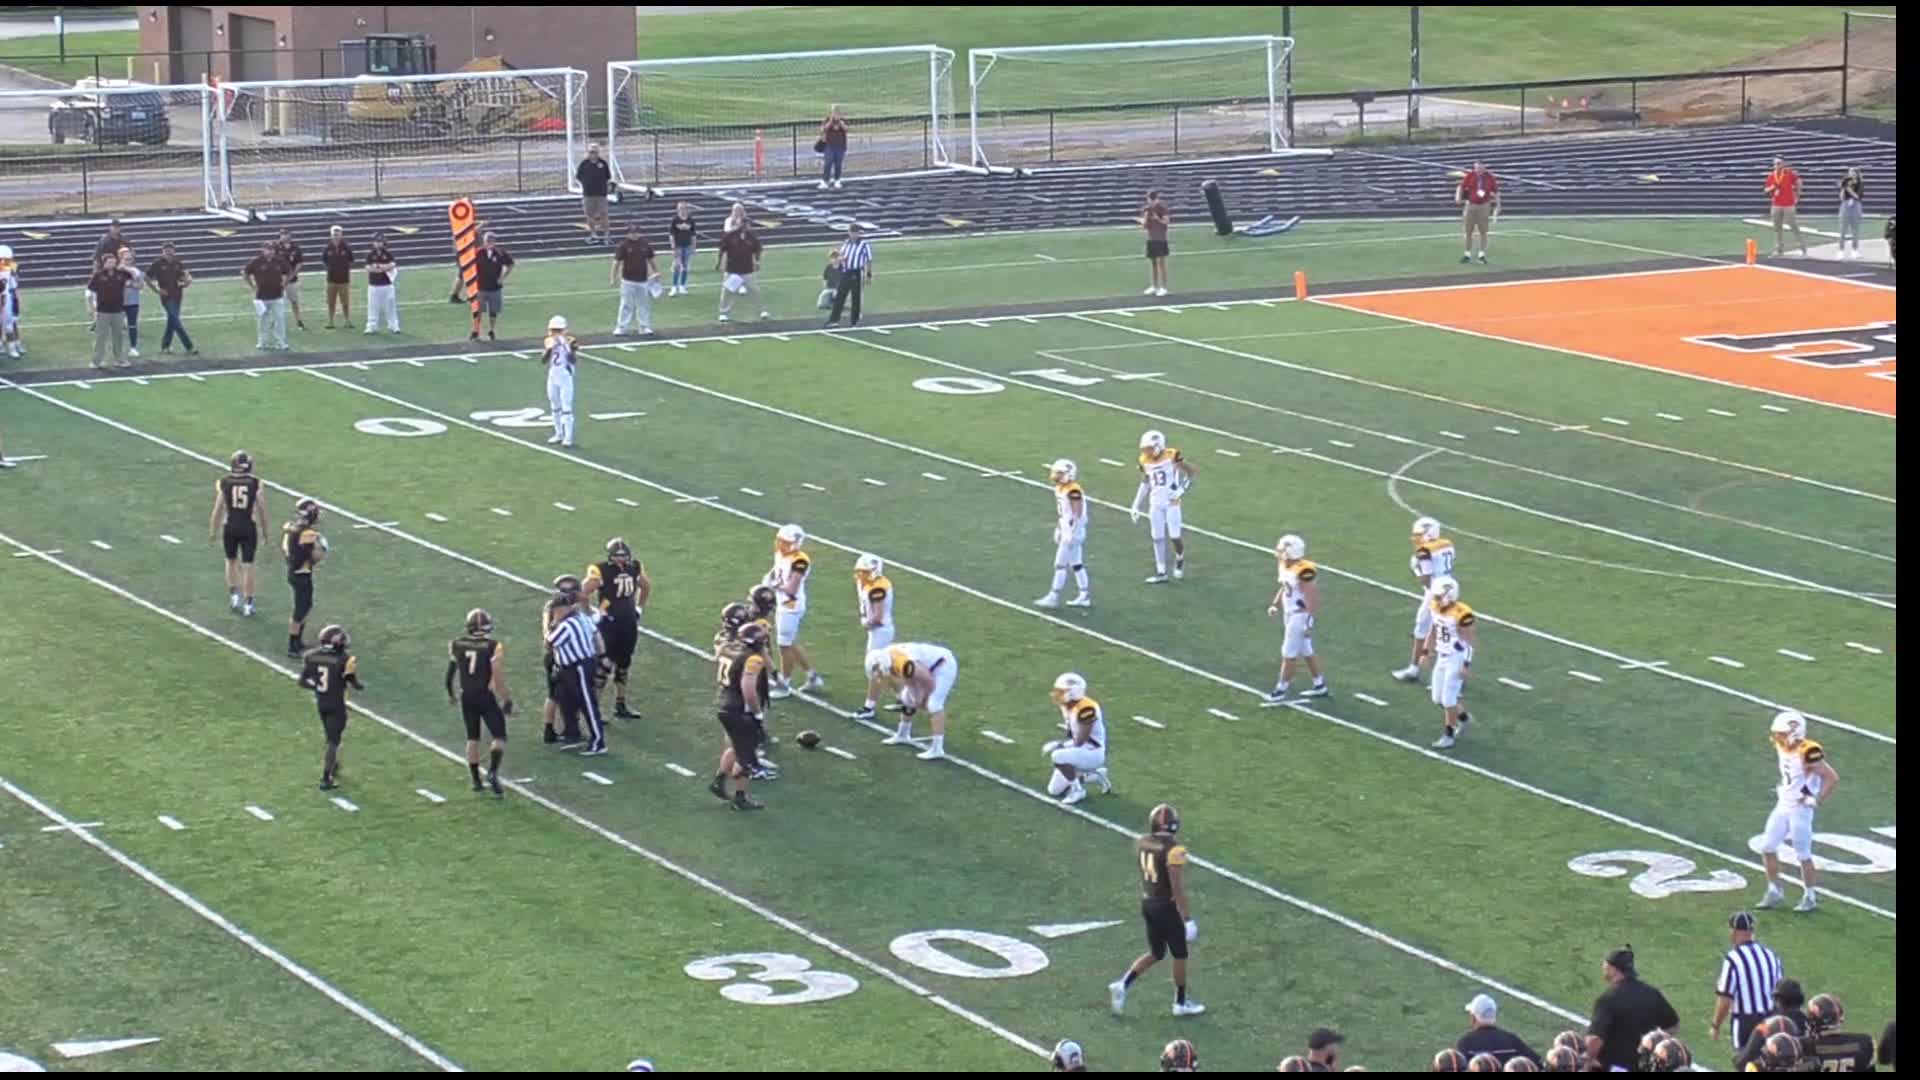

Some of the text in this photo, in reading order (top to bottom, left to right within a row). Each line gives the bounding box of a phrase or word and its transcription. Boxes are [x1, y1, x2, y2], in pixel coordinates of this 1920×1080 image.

[1150, 469, 1167, 487] 13
[230, 485, 249, 509] 15
[613, 577, 634, 599] 70
[463, 650, 477, 675] 7
[316, 665, 329, 693] 3
